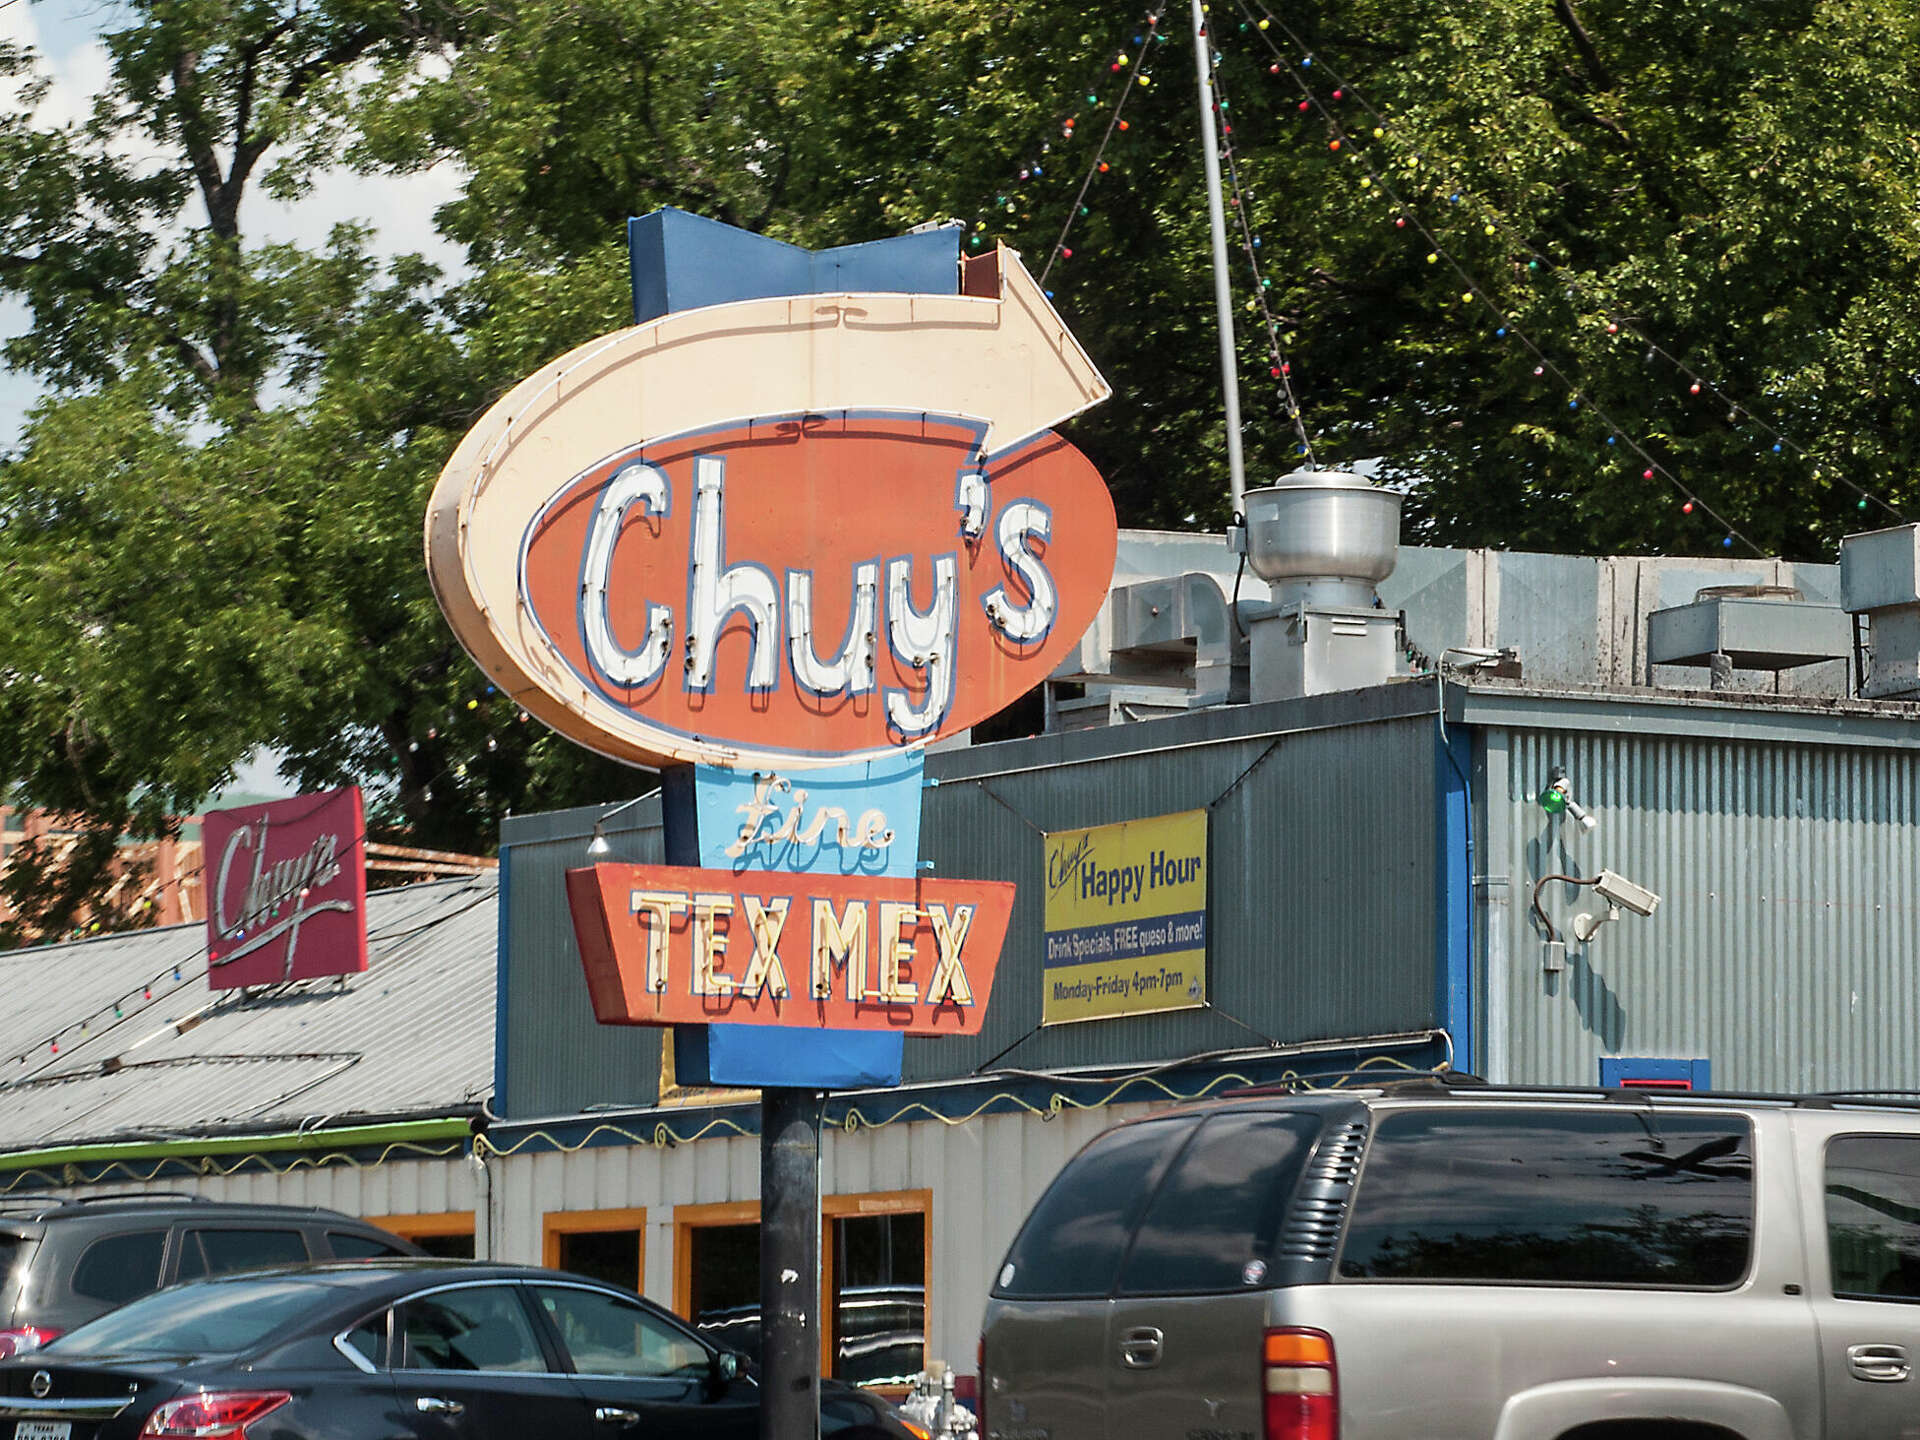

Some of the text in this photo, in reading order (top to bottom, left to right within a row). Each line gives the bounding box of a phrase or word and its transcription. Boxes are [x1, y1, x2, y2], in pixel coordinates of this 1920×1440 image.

[579, 457, 1055, 738] Chuy's
[724, 775, 895, 858] fine
[1081, 850, 1201, 905] Happy Hour
[630, 890, 977, 1007] TEX MEX
[1048, 915, 1204, 961] Drink Specials, FREE queso & more!
[1132, 967, 1183, 996] 4pm-7pm
